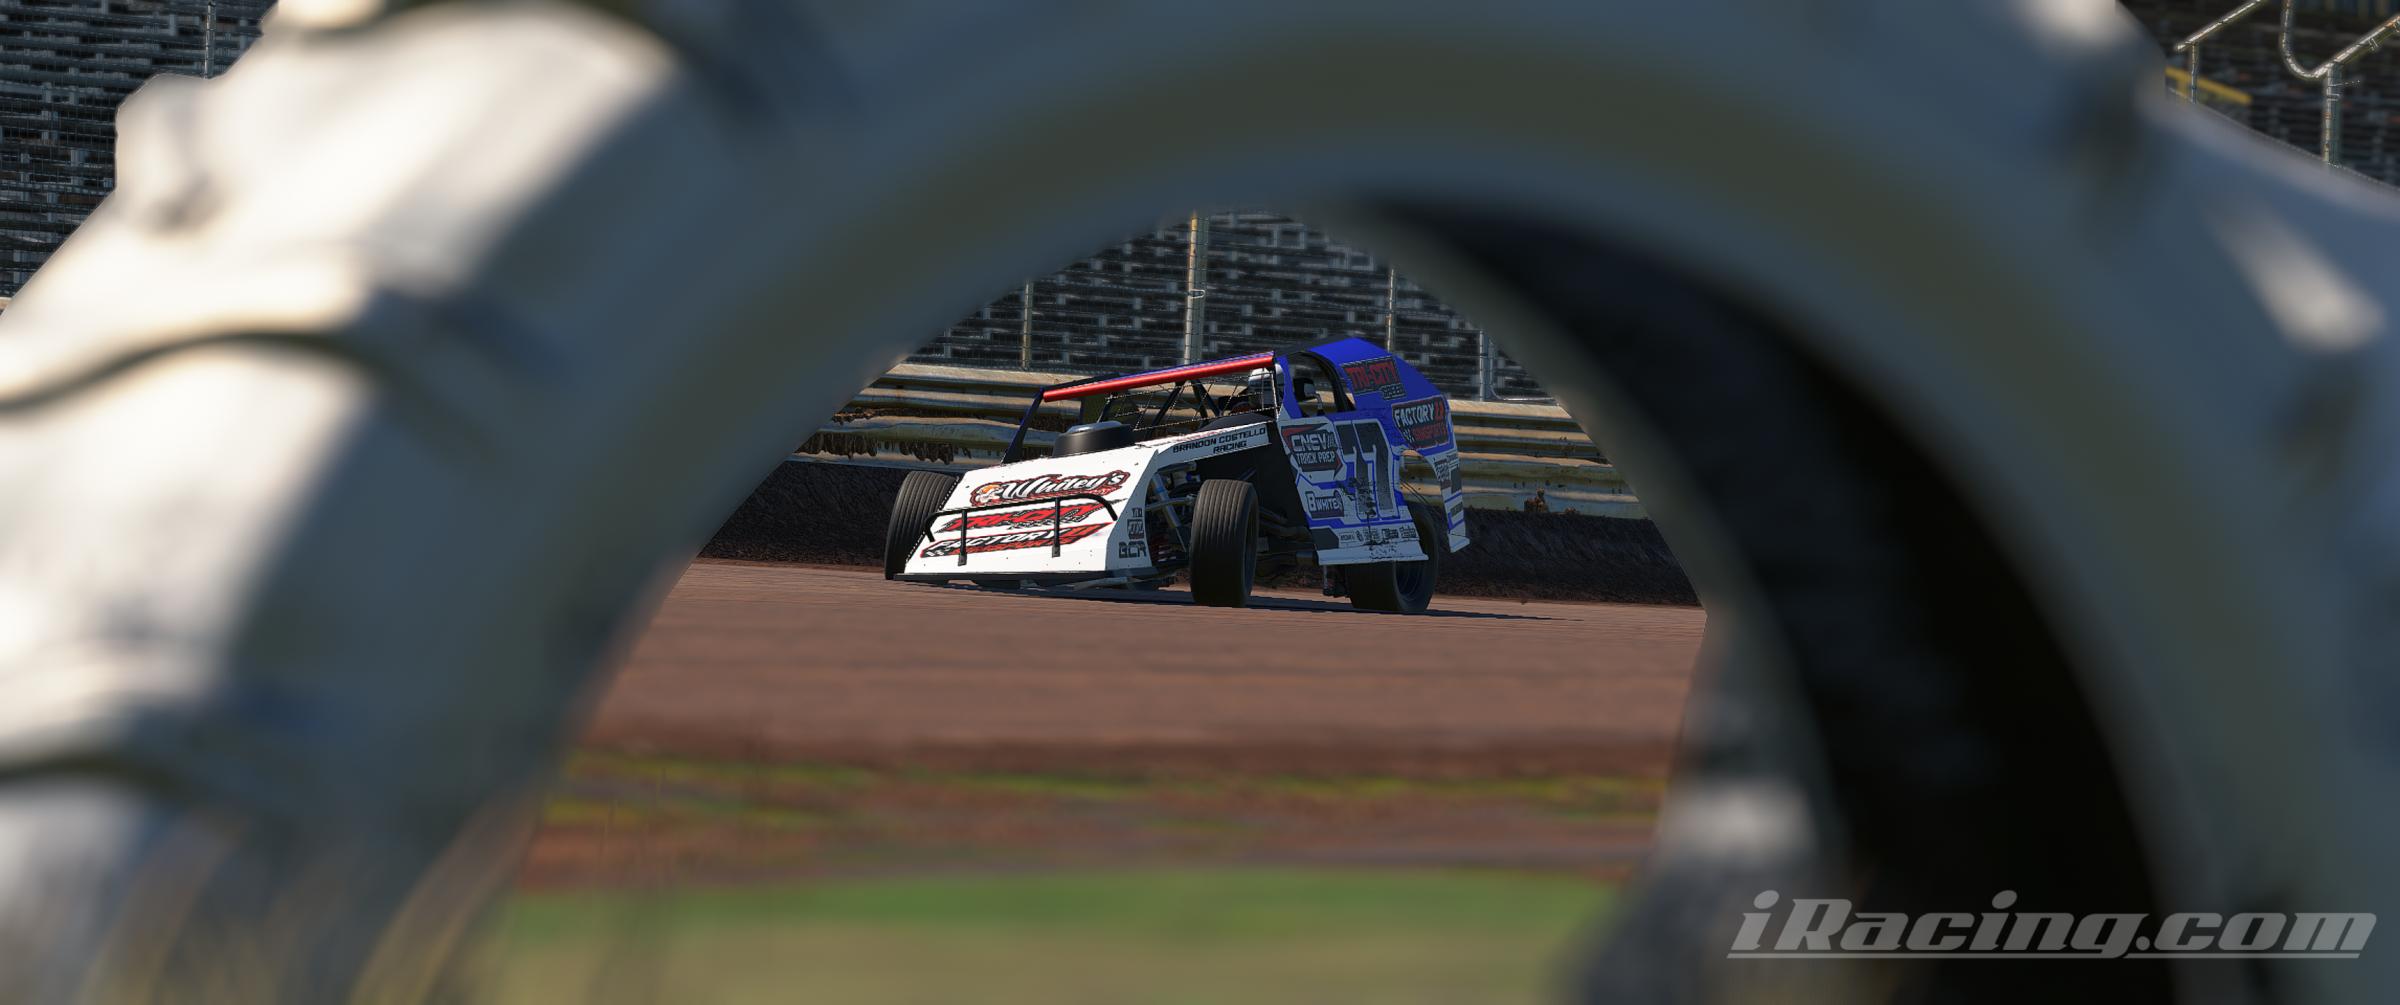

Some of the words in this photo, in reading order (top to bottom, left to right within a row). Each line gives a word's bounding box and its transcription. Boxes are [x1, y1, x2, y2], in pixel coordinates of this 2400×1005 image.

[1394, 403, 1434, 428] FACTORY
[1173, 438, 1217, 453] BRANDON
[1219, 427, 1266, 443] COSTELLO
[1213, 440, 1247, 454] RACING
[1296, 452, 1318, 465] TRACK
[1318, 450, 1336, 464] PREP
